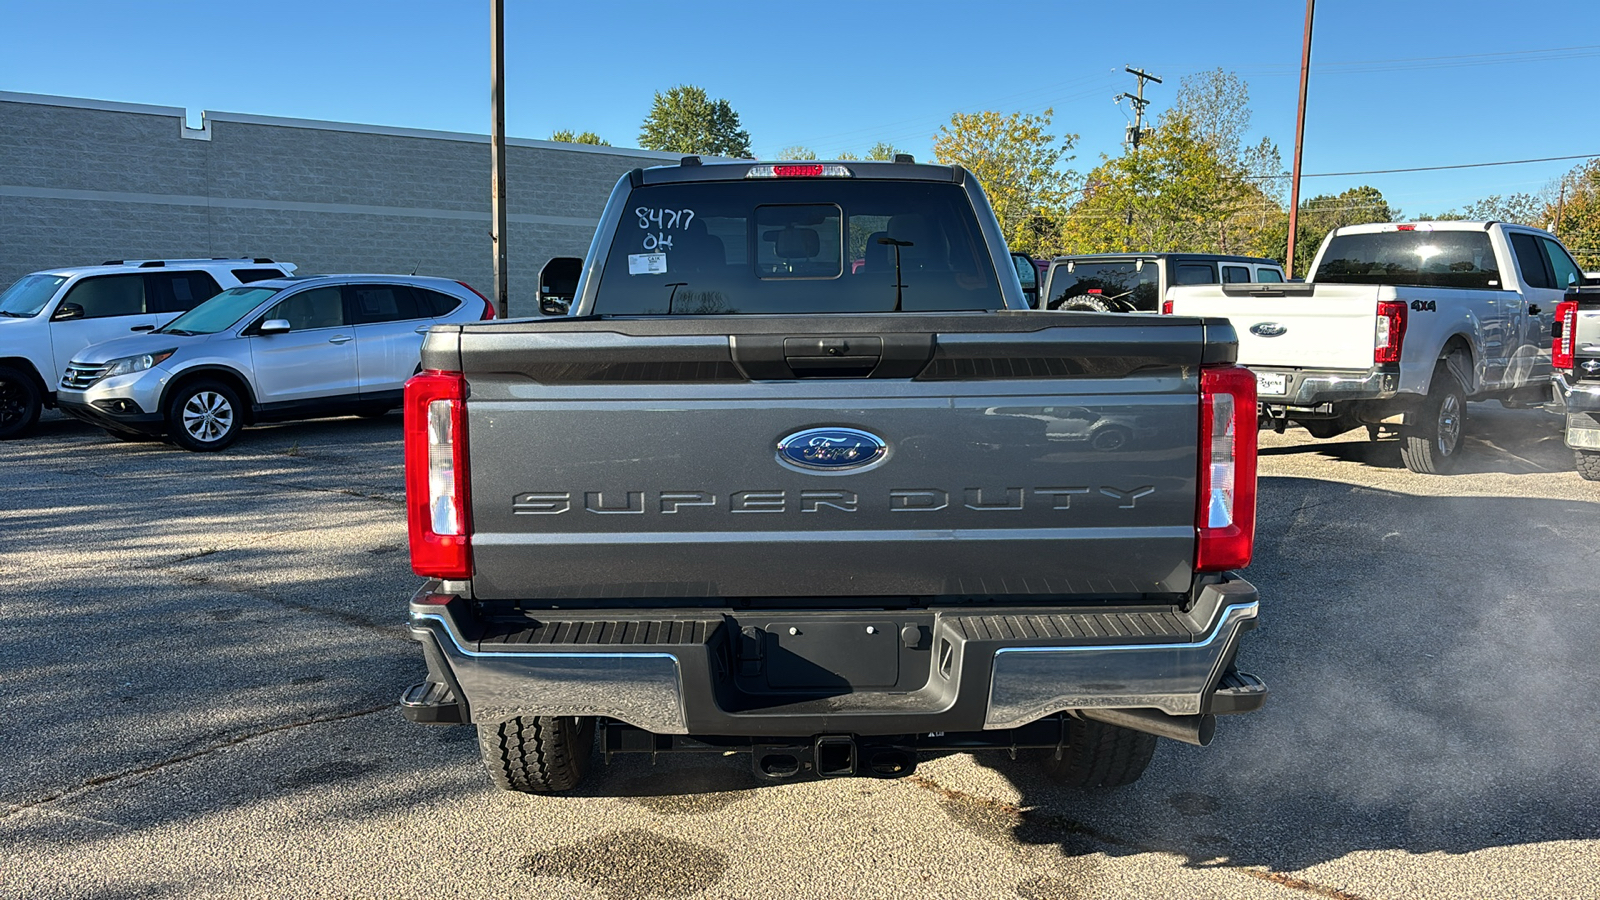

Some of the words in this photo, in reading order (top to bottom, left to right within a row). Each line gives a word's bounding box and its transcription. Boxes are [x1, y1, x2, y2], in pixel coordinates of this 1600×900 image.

[635, 206, 695, 230] 84717
[804, 436, 861, 460] Ford
[512, 489, 858, 515] SUPER
[889, 486, 1156, 512] DUTY
